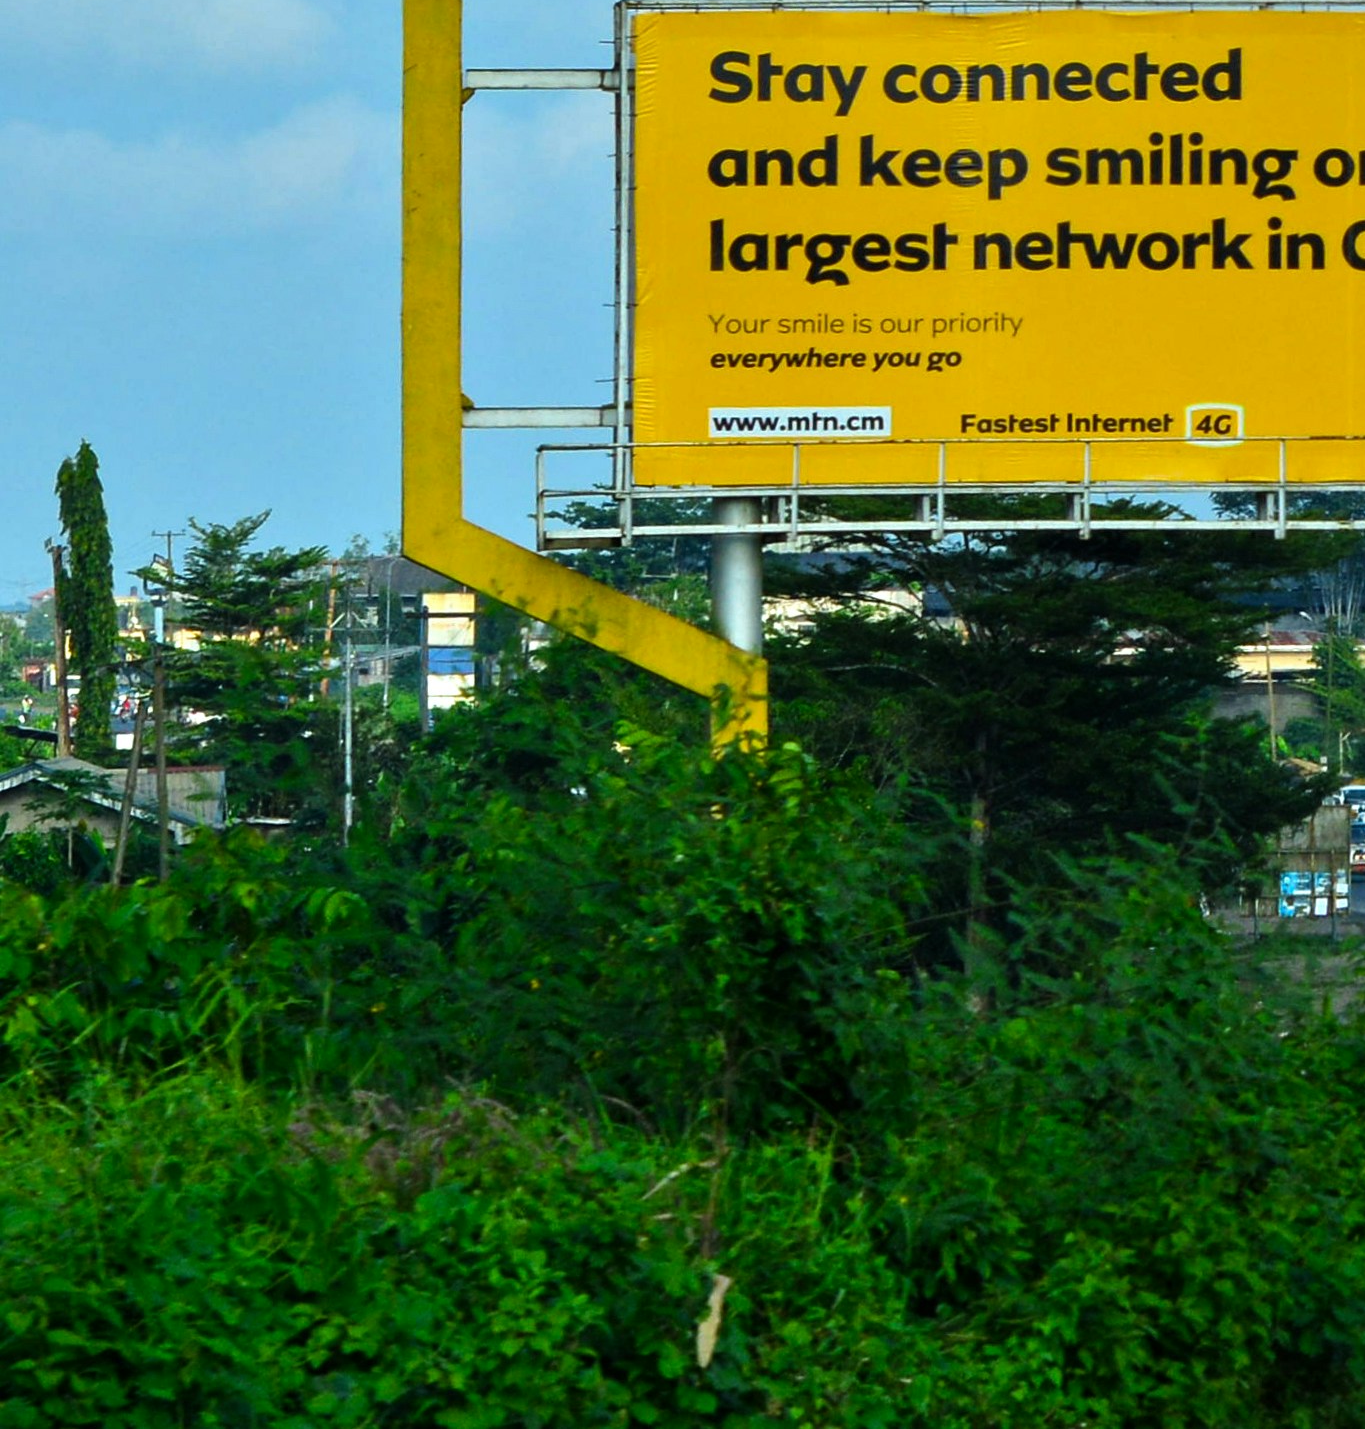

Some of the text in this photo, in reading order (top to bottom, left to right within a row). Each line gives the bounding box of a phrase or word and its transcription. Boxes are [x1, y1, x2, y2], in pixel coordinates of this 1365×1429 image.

[708, 47, 1243, 117] Stay connected
[707, 133, 839, 188] and
[859, 133, 1029, 201] keep
[1045, 131, 1299, 201] smiling
[710, 218, 959, 287] largest
[973, 216, 1254, 271] network
[1267, 216, 1326, 270] in
[707, 311, 1025, 339] Your smile is our priority
[710, 346, 963, 372] everywhere you go
[712, 412, 885, 432] www.mtn.cm
[960, 412, 1233, 436] Fastest Internet 4G
